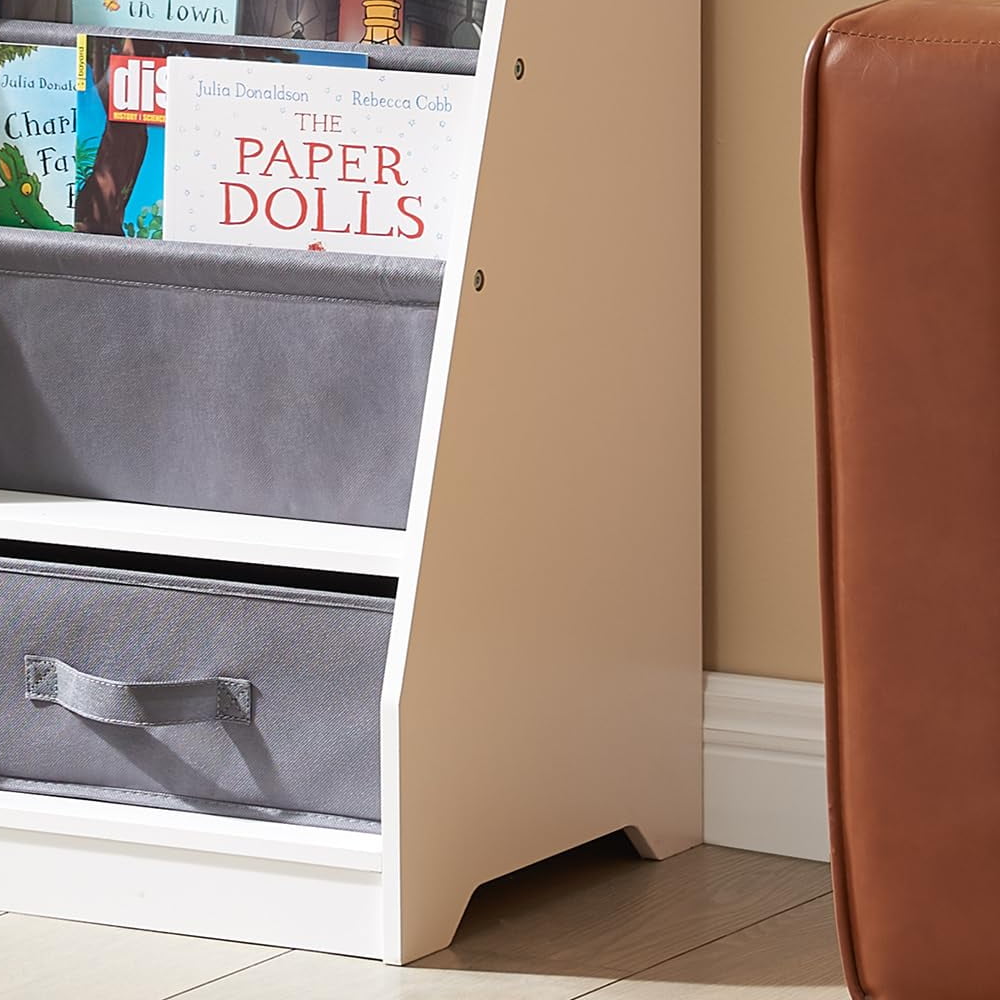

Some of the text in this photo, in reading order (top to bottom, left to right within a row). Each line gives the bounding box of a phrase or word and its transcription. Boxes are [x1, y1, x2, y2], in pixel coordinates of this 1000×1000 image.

[1, 74, 35, 89] Julia
[195, 79, 310, 102] Julia Donaldson
[352, 90, 452, 112] Rebecca Cobb
[294, 112, 342, 133] THE
[37, 147, 77, 177] Fa
[234, 138, 408, 186] PAPER
[219, 182, 425, 240] DOLLS
